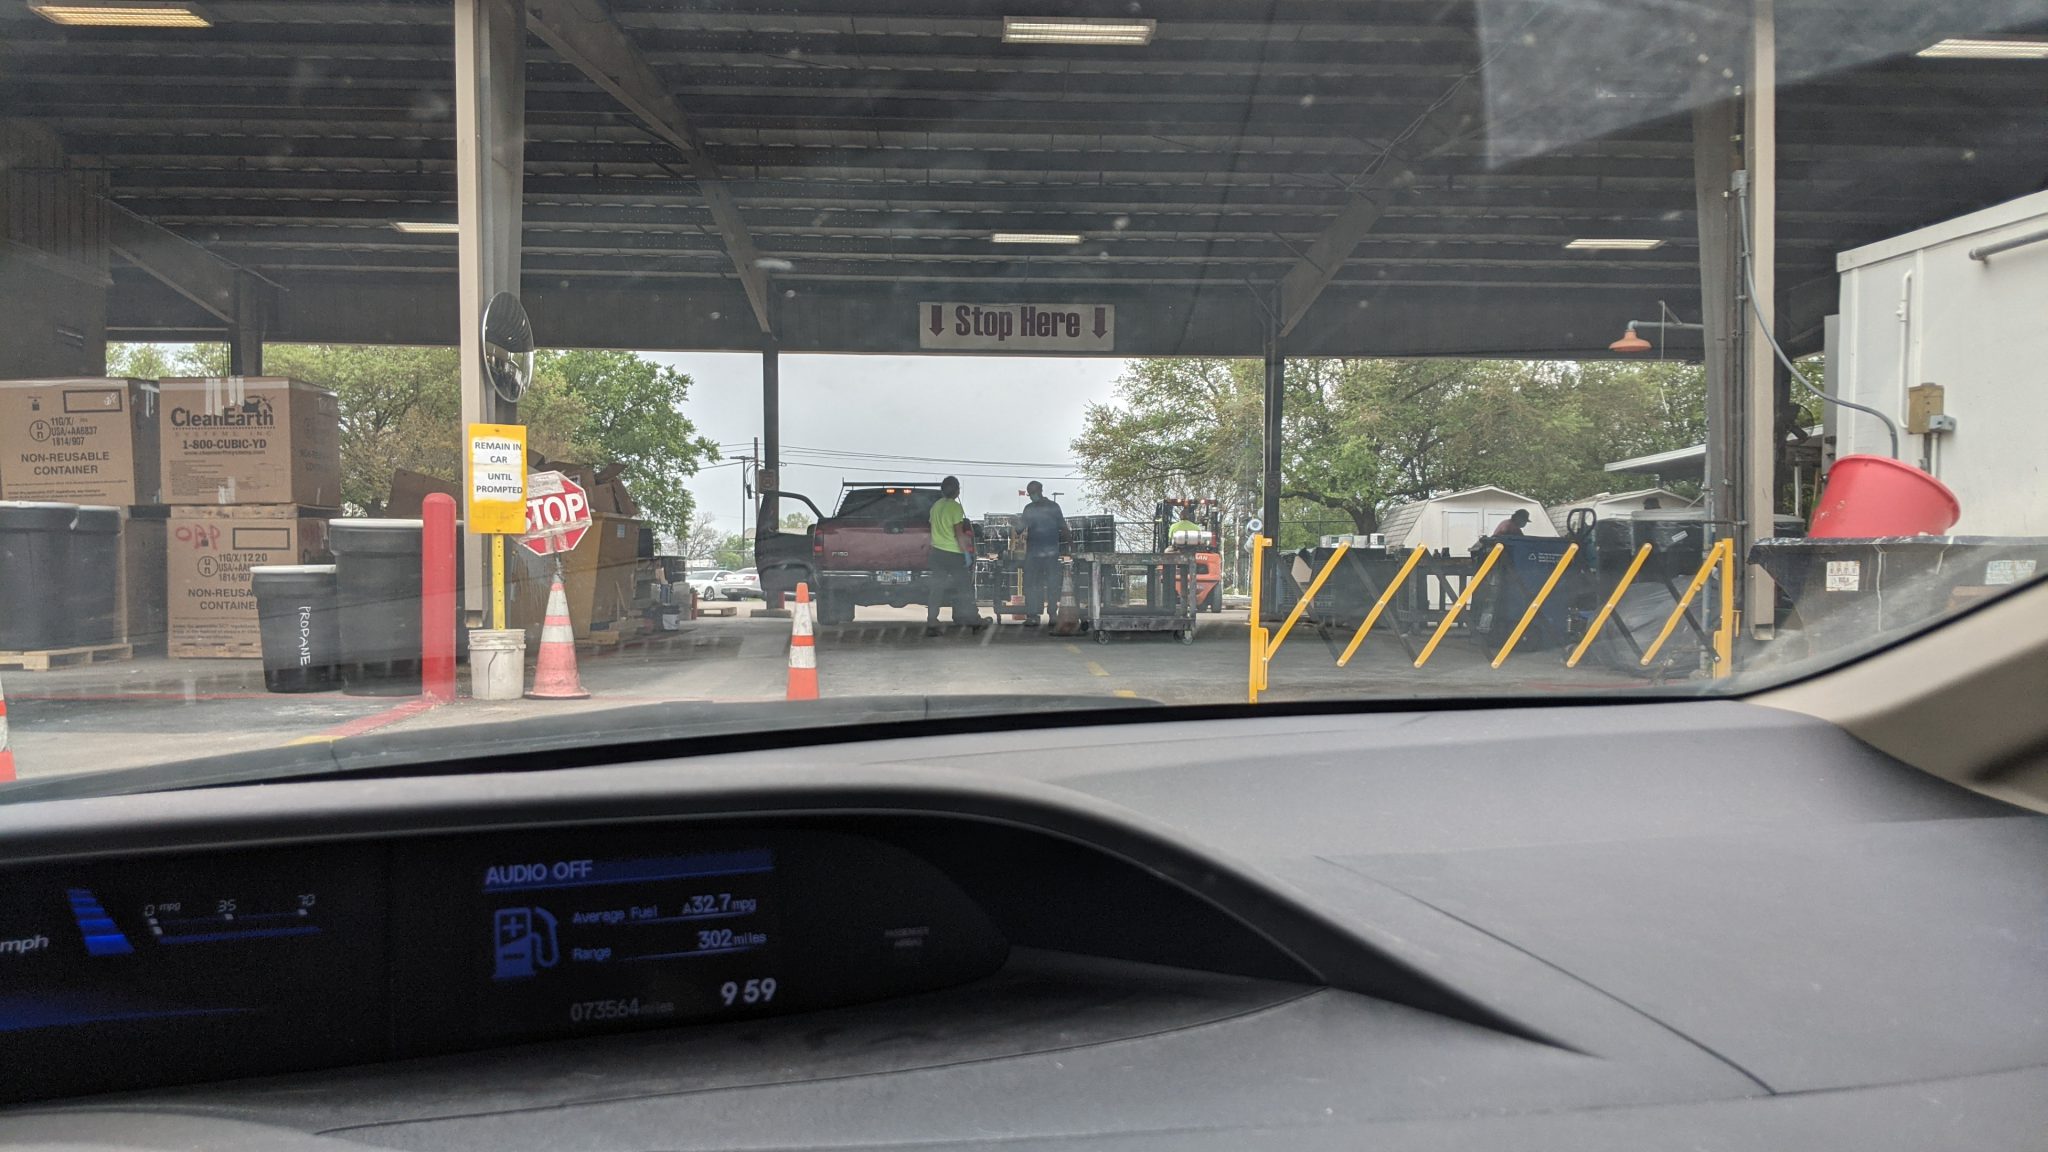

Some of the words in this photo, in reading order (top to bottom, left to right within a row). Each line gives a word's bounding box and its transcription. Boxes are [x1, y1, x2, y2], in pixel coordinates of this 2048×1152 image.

[955, 305, 1013, 341] Stop
[1020, 306, 1081, 338] Here
[170, 407, 275, 428] CleanEarth
[182, 438, 268, 450] 1-800-CUBIC-YD
[474, 441, 511, 451] REMAIN
[513, 443, 522, 451] IN
[20, 451, 110, 463] NON-REUSABLE
[490, 455, 508, 464] CAR
[33, 464, 99, 476] CONTAINER
[487, 473, 512, 481] UNTIL
[476, 485, 523, 494] PROMPTED
[188, 589, 253, 598] NON-REUSA
[299, 606, 312, 666] PROPANE
[484, 865, 548, 885] AUDIO
[552, 859, 594, 878] OFF
[158, 901, 181, 912] mpg
[217, 899, 237, 913] 35
[573, 910, 626, 924] Average
[630, 904, 658, 921] Fuel
[0, 933, 49, 953] mph
[572, 946, 612, 963] Range
